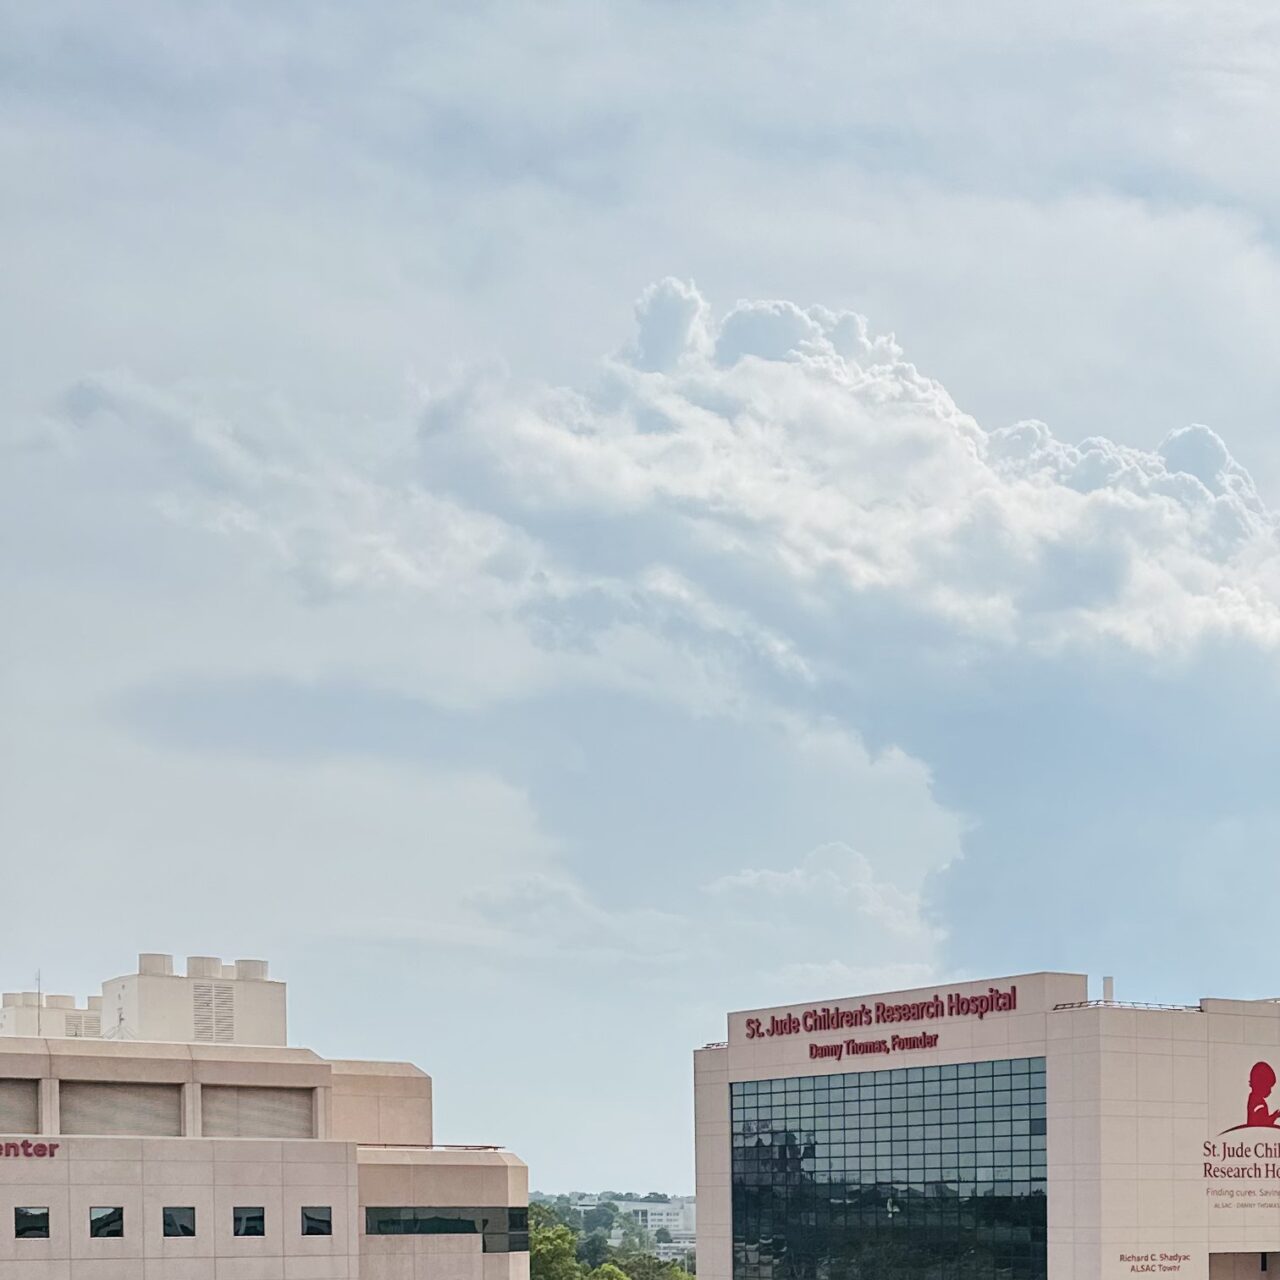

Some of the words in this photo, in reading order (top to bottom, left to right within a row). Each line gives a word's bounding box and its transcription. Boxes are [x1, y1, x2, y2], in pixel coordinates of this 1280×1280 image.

[746, 1018, 765, 1039] St.
[766, 1013, 800, 1036] Jude
[802, 1004, 872, 1032] Children's
[875, 994, 944, 1023] Research
[947, 985, 1016, 1020] Hospital
[809, 1043, 843, 1061] Danny
[843, 1039, 890, 1055] Thomas,
[891, 1031, 939, 1051] Founder
[0, 1139, 60, 1157] nter
[1203, 1140, 1220, 1158] St.
[1221, 1142, 1252, 1162] Jude
[1203, 1162, 1262, 1179] Research
[1206, 1187, 1234, 1199] Finding
[1119, 1253, 1149, 1262] Richard
[1130, 1264, 1156, 1273] ALSAC
[1157, 1264, 1181, 1272] Tower
